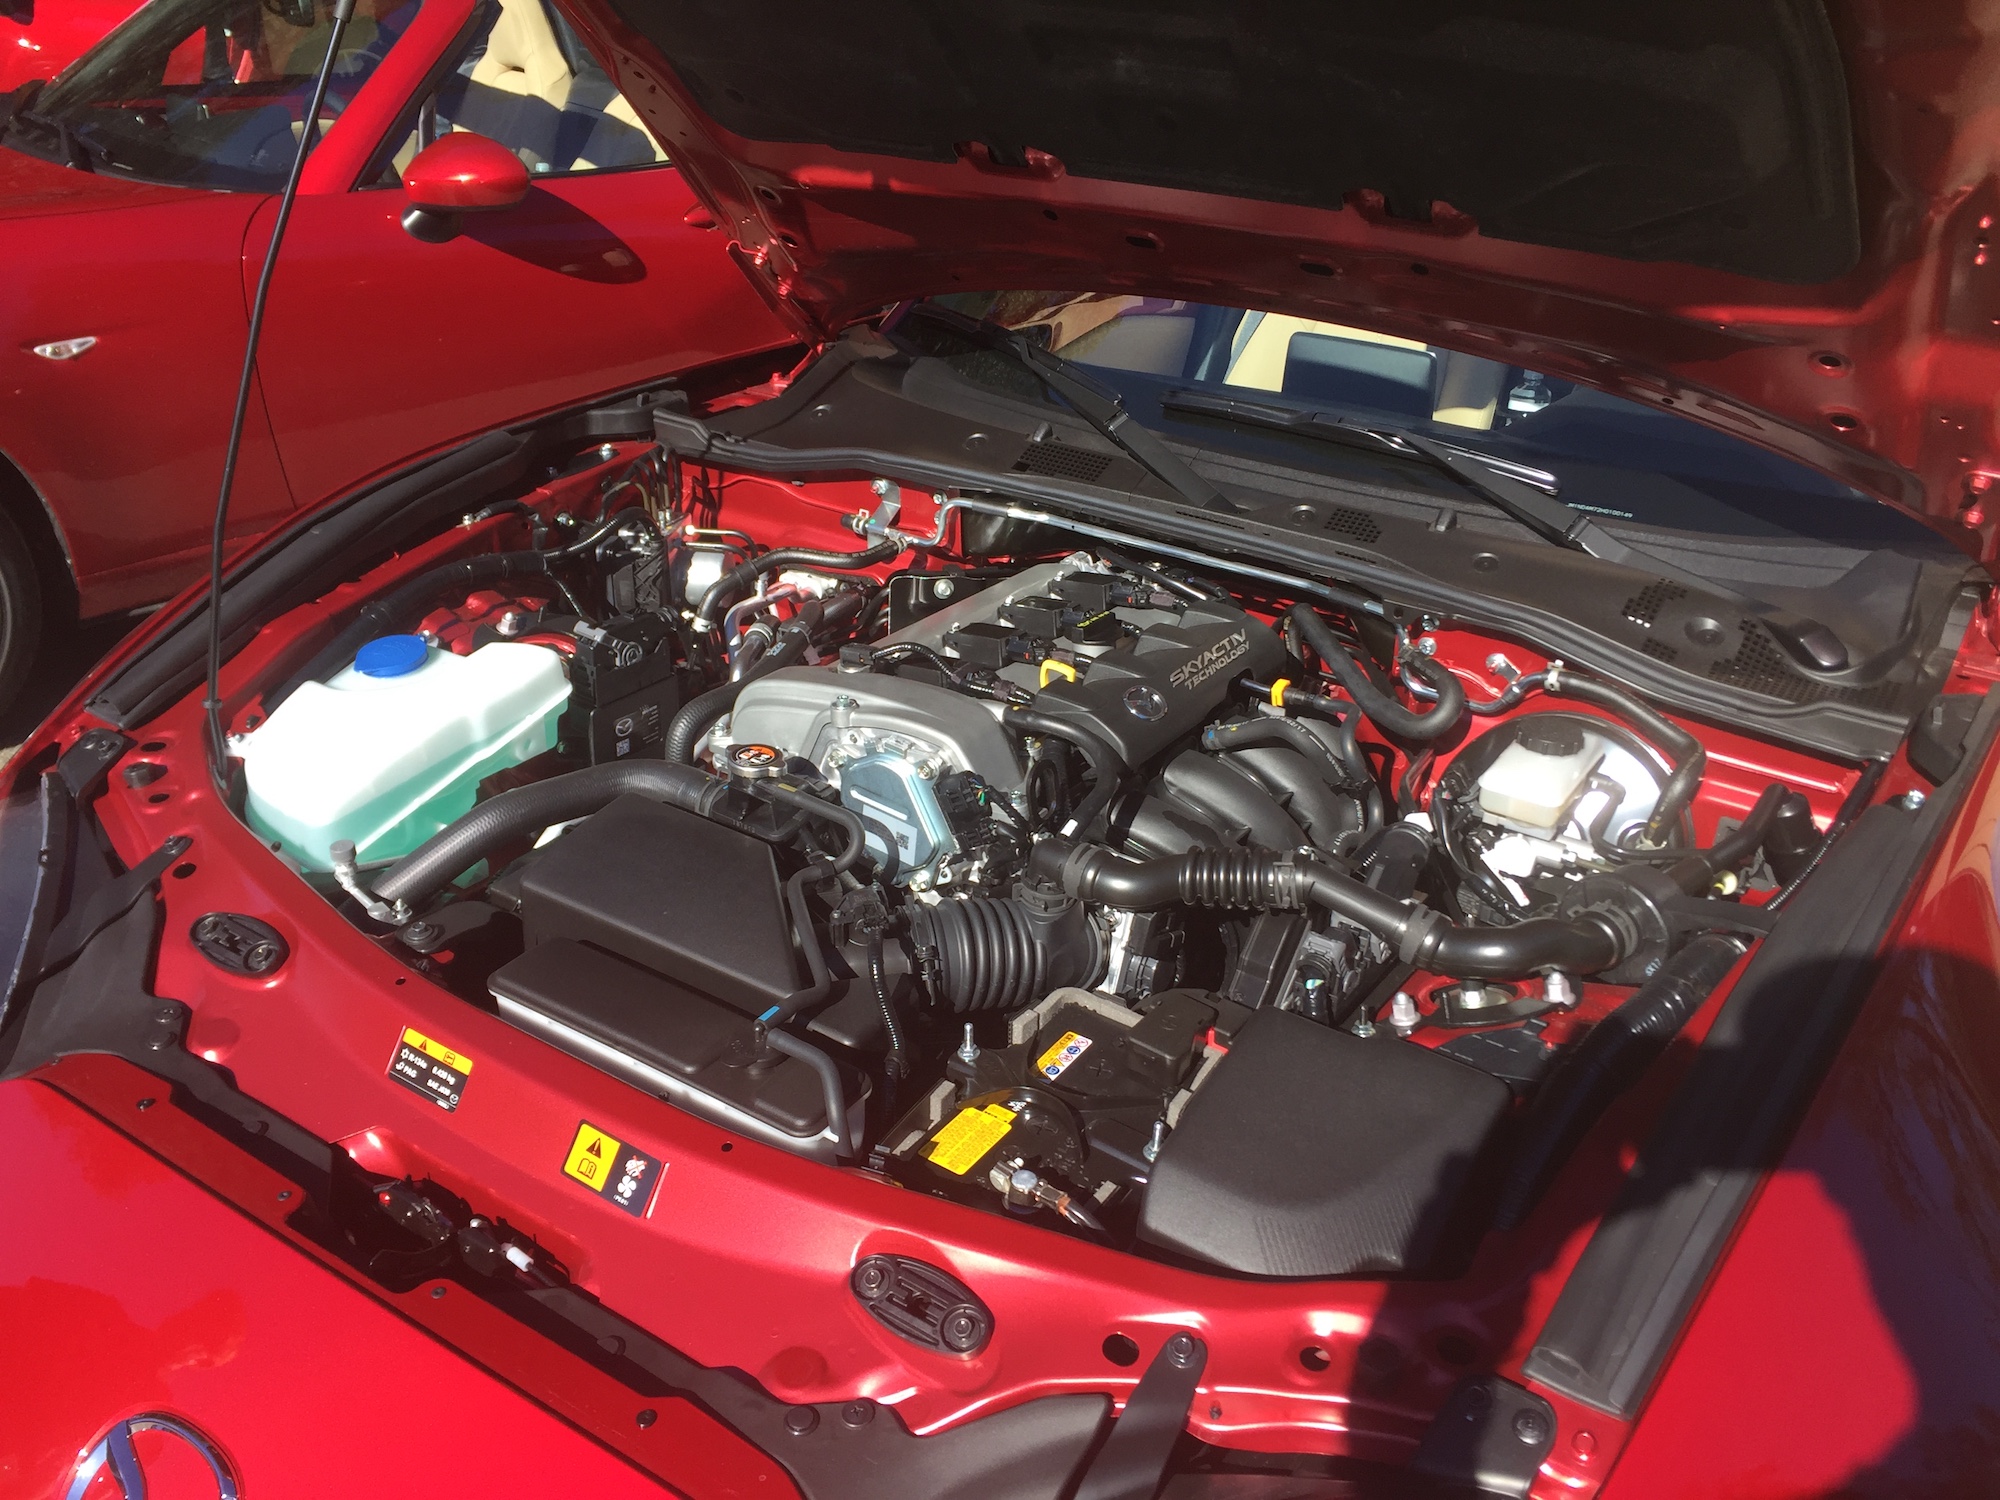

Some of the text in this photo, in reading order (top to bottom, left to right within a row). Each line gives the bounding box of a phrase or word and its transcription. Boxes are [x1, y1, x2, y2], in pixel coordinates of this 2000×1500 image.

[1169, 628, 1247, 688] SKYACTIV
[1185, 641, 1250, 690] TECHNOLOGY
[403, 1065, 417, 1078] PAG
[426, 1079, 440, 1090] SAE
[408, 1053, 428, 1069] R-134a
[446, 1073, 456, 1085] kg
